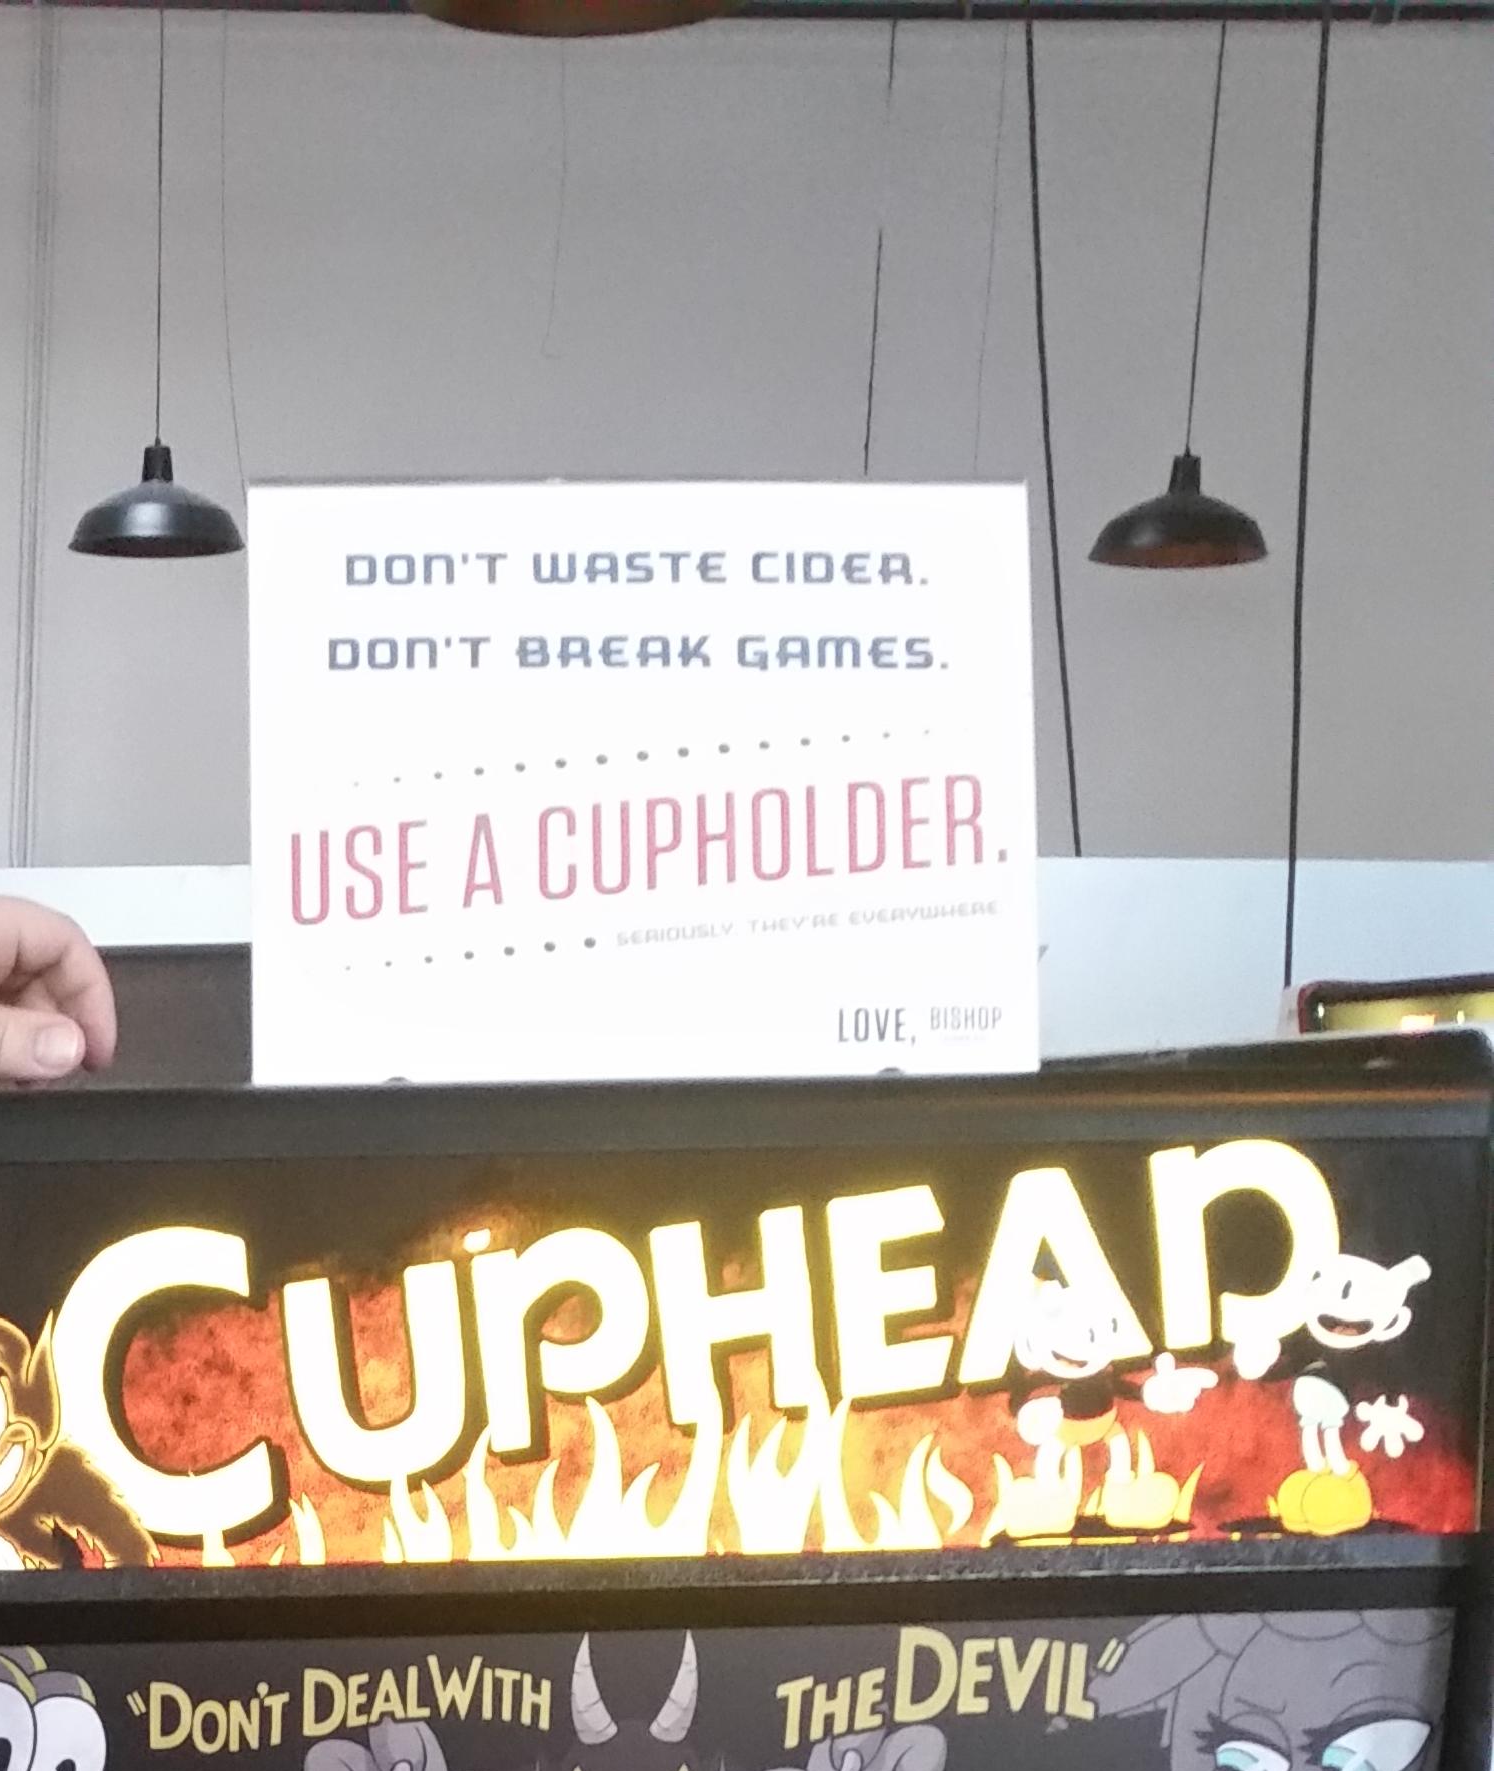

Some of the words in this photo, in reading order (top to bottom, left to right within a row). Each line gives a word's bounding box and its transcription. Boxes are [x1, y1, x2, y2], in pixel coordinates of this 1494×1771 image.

[346, 552, 508, 586] DON'T
[532, 551, 727, 584] WASTE
[751, 551, 928, 585] CIDER.
[328, 636, 491, 671] DON'T
[515, 635, 711, 669] BREAK
[737, 635, 948, 671] GAMES.
[290, 820, 428, 926] USE
[462, 812, 503, 909] A
[537, 774, 1008, 900] CUPHOLDER.
[748, 911, 838, 935] THEY'RE
[838, 1007, 916, 1046] LOVE,
[929, 1006, 1003, 1031] BISHOP
[54, 1138, 1342, 1538] CUPHEAD
[777, 1667, 887, 1750] THE
